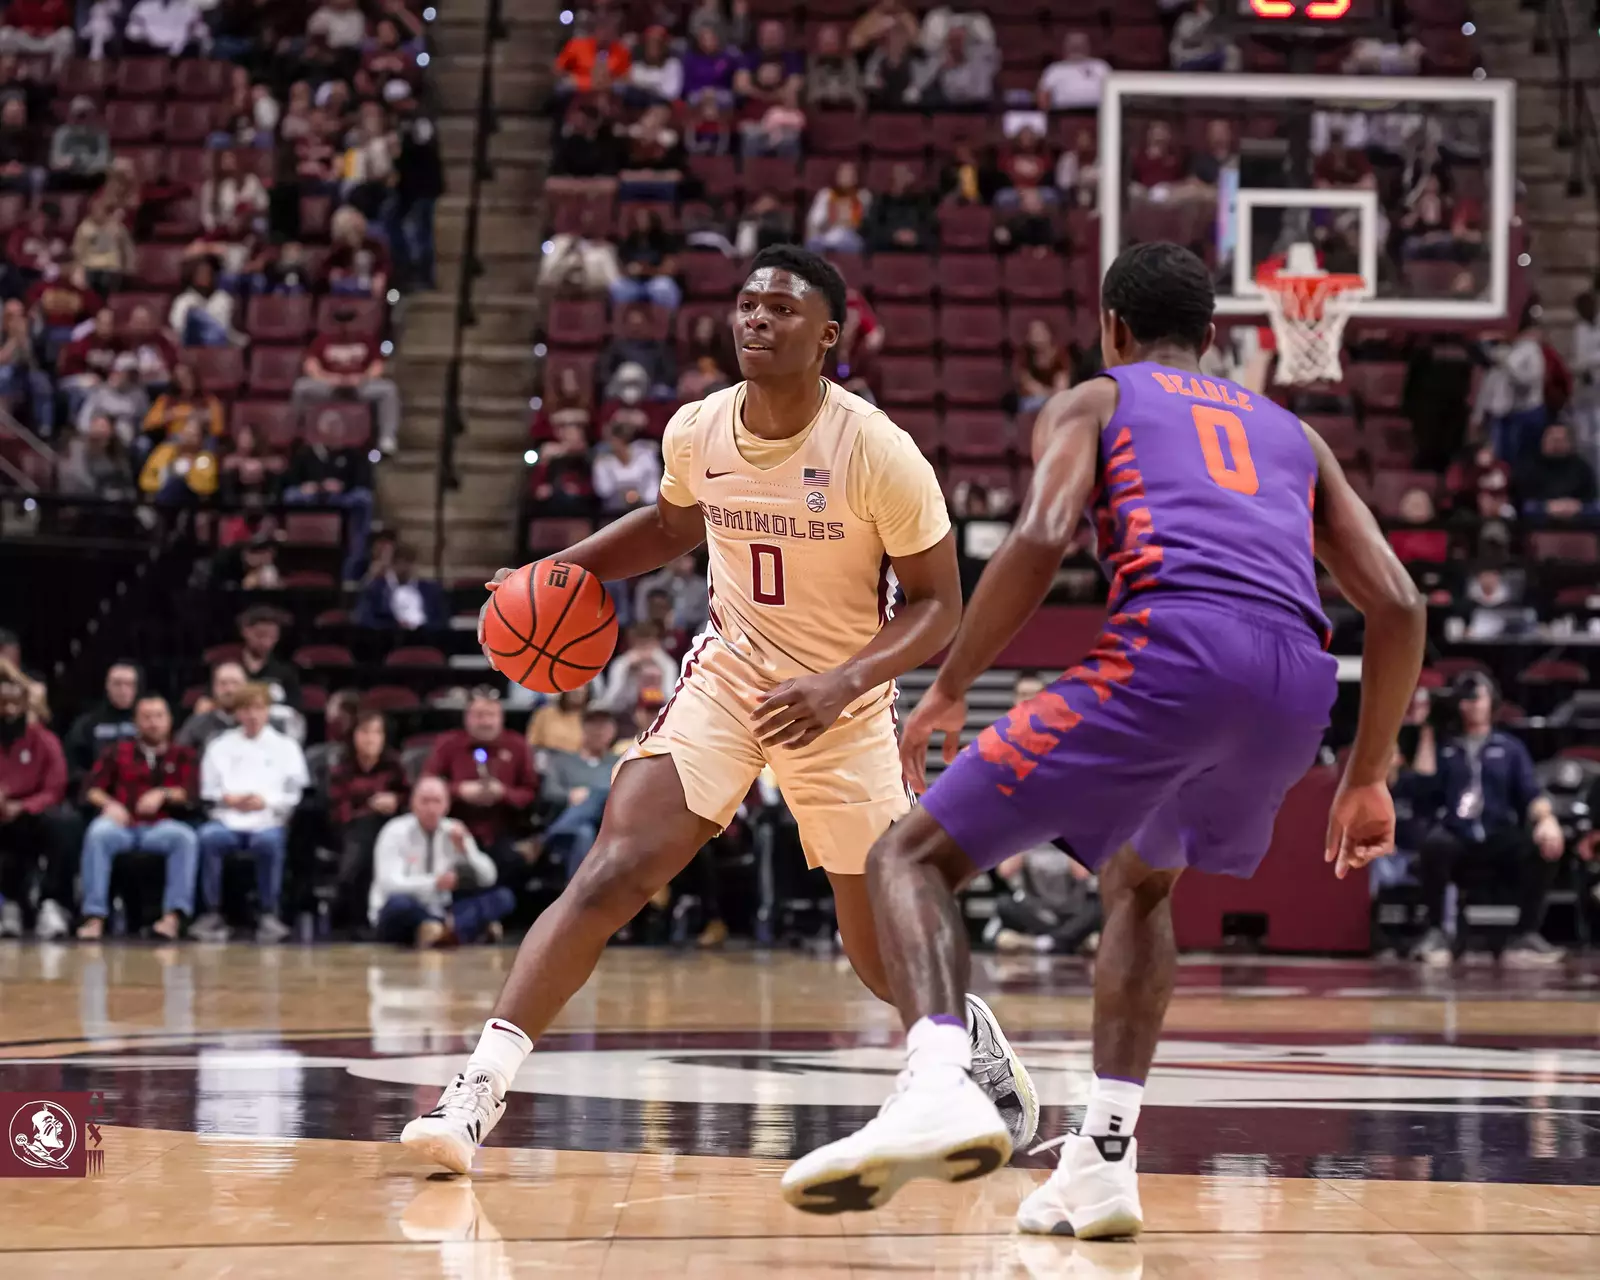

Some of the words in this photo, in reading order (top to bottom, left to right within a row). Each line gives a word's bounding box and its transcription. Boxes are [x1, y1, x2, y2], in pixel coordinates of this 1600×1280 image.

[1191, 403, 1260, 496] 0
[697, 499, 846, 541] SEMINOLES
[749, 543, 786, 607] 0
